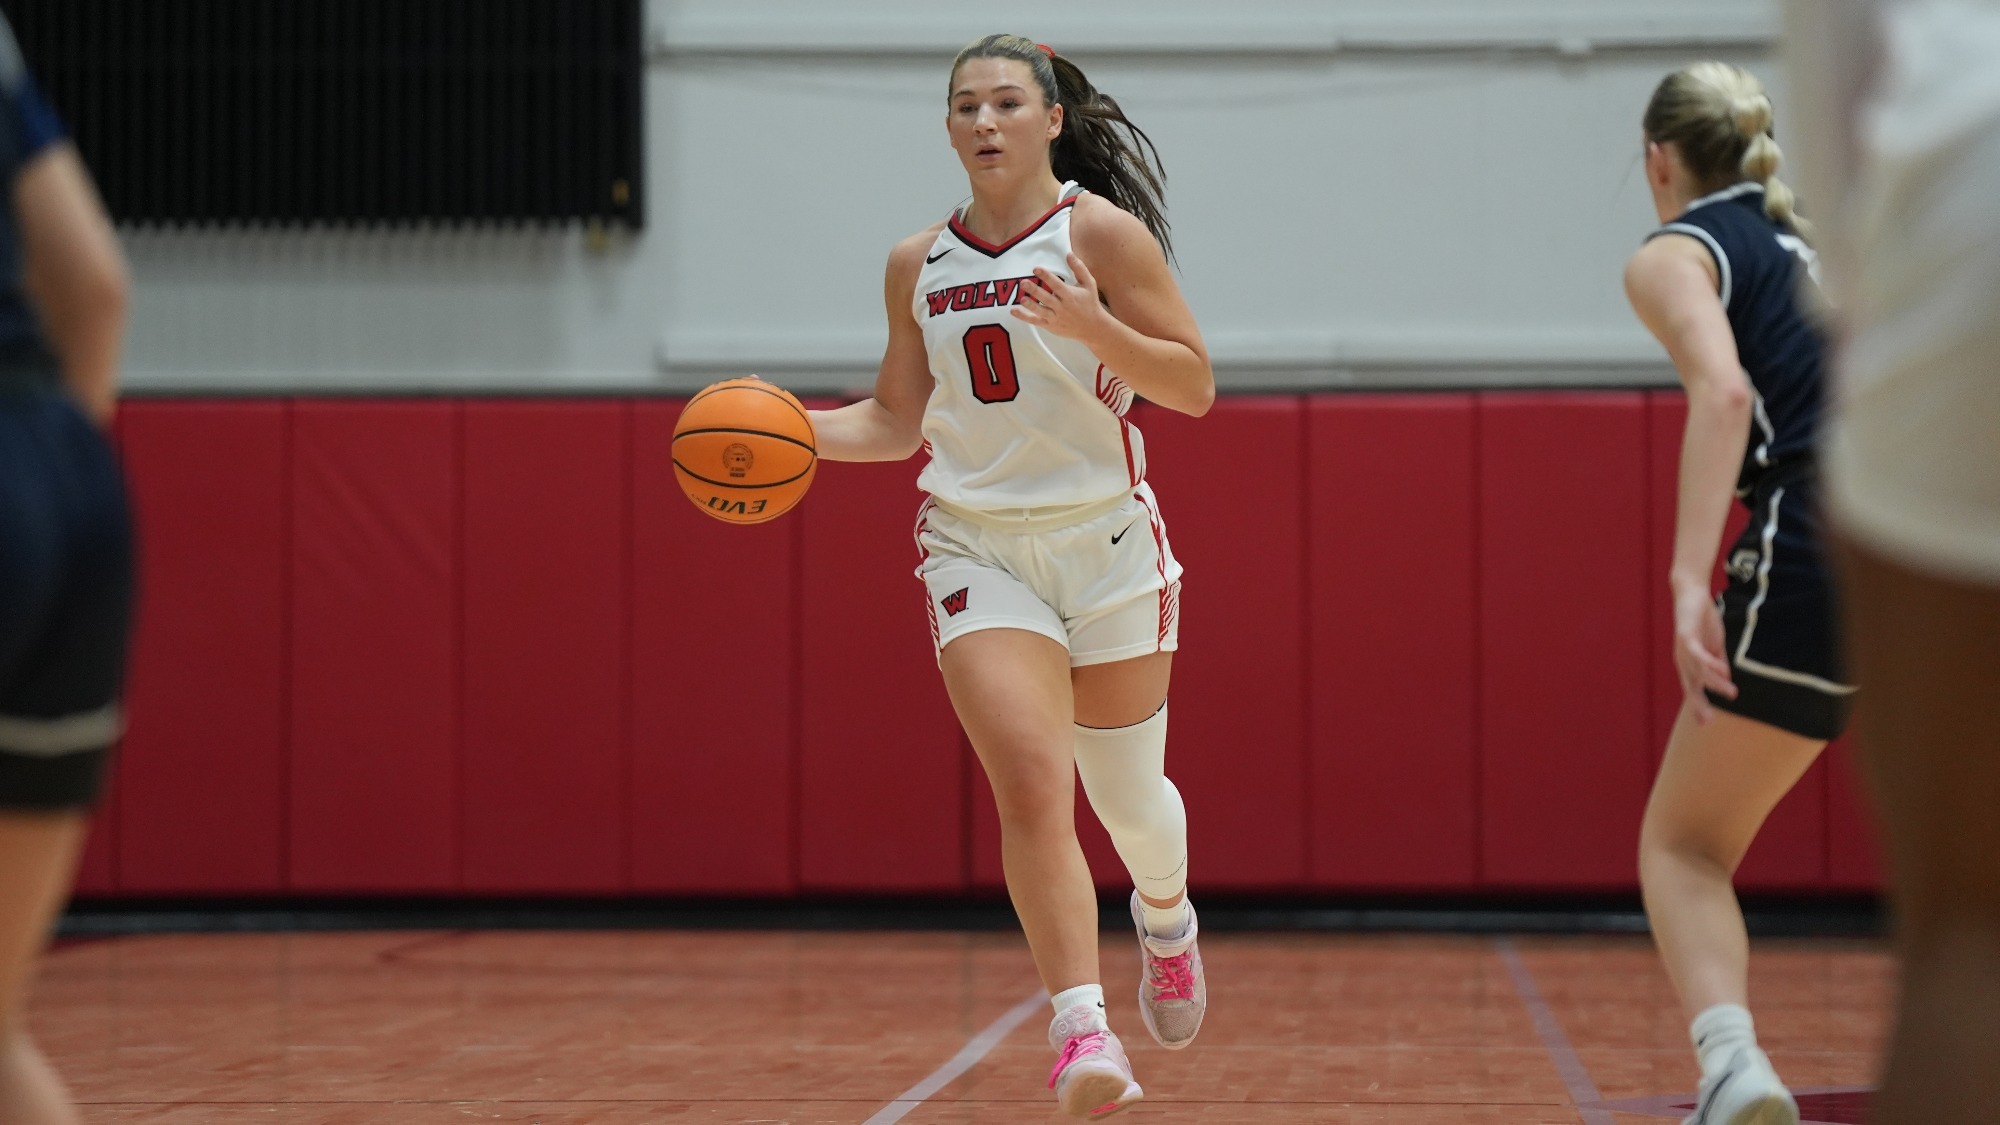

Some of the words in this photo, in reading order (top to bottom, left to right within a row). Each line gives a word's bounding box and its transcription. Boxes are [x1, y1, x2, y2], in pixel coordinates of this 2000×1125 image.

[963, 323, 1020, 404] 0
[707, 496, 768, 515] EVO
[940, 586, 969, 617] W
